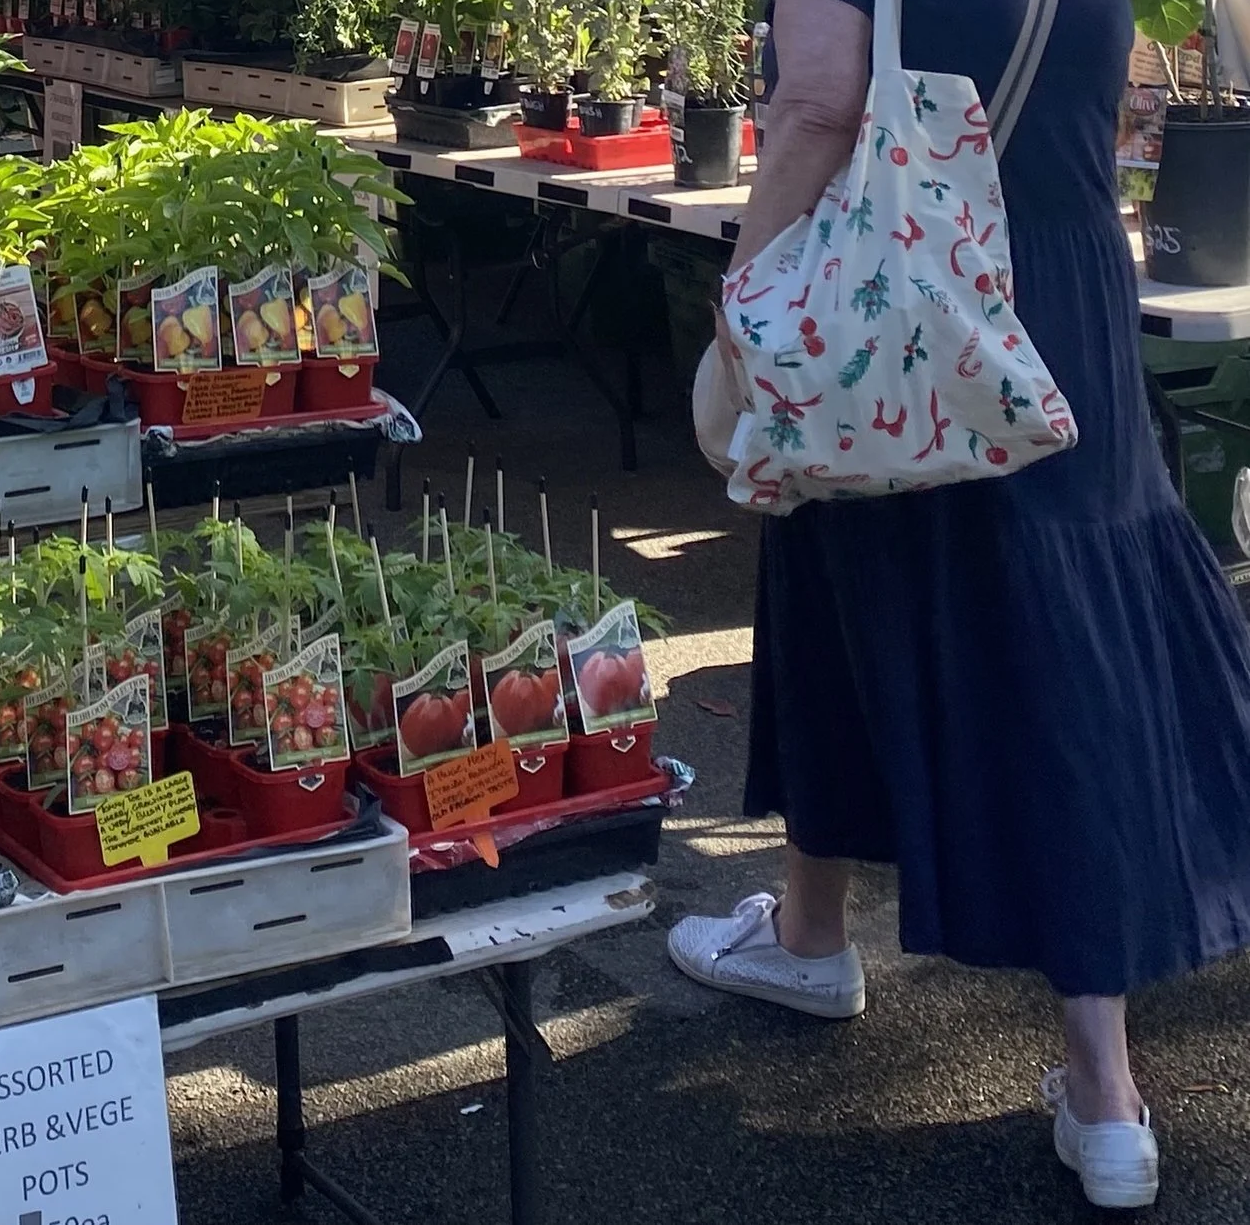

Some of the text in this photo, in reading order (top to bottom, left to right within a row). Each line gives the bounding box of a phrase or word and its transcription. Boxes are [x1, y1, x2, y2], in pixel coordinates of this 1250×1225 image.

[1130, 94, 1157, 111] Olive
[126, 610, 161, 634] ELECTION
[265, 635, 338, 686] HEIRLOOM SELECTION
[68, 676, 148, 725] HEIRLOOM SELECTION
[136, 803, 167, 821] BUSHY
[22, 1160, 90, 1201] POTS
